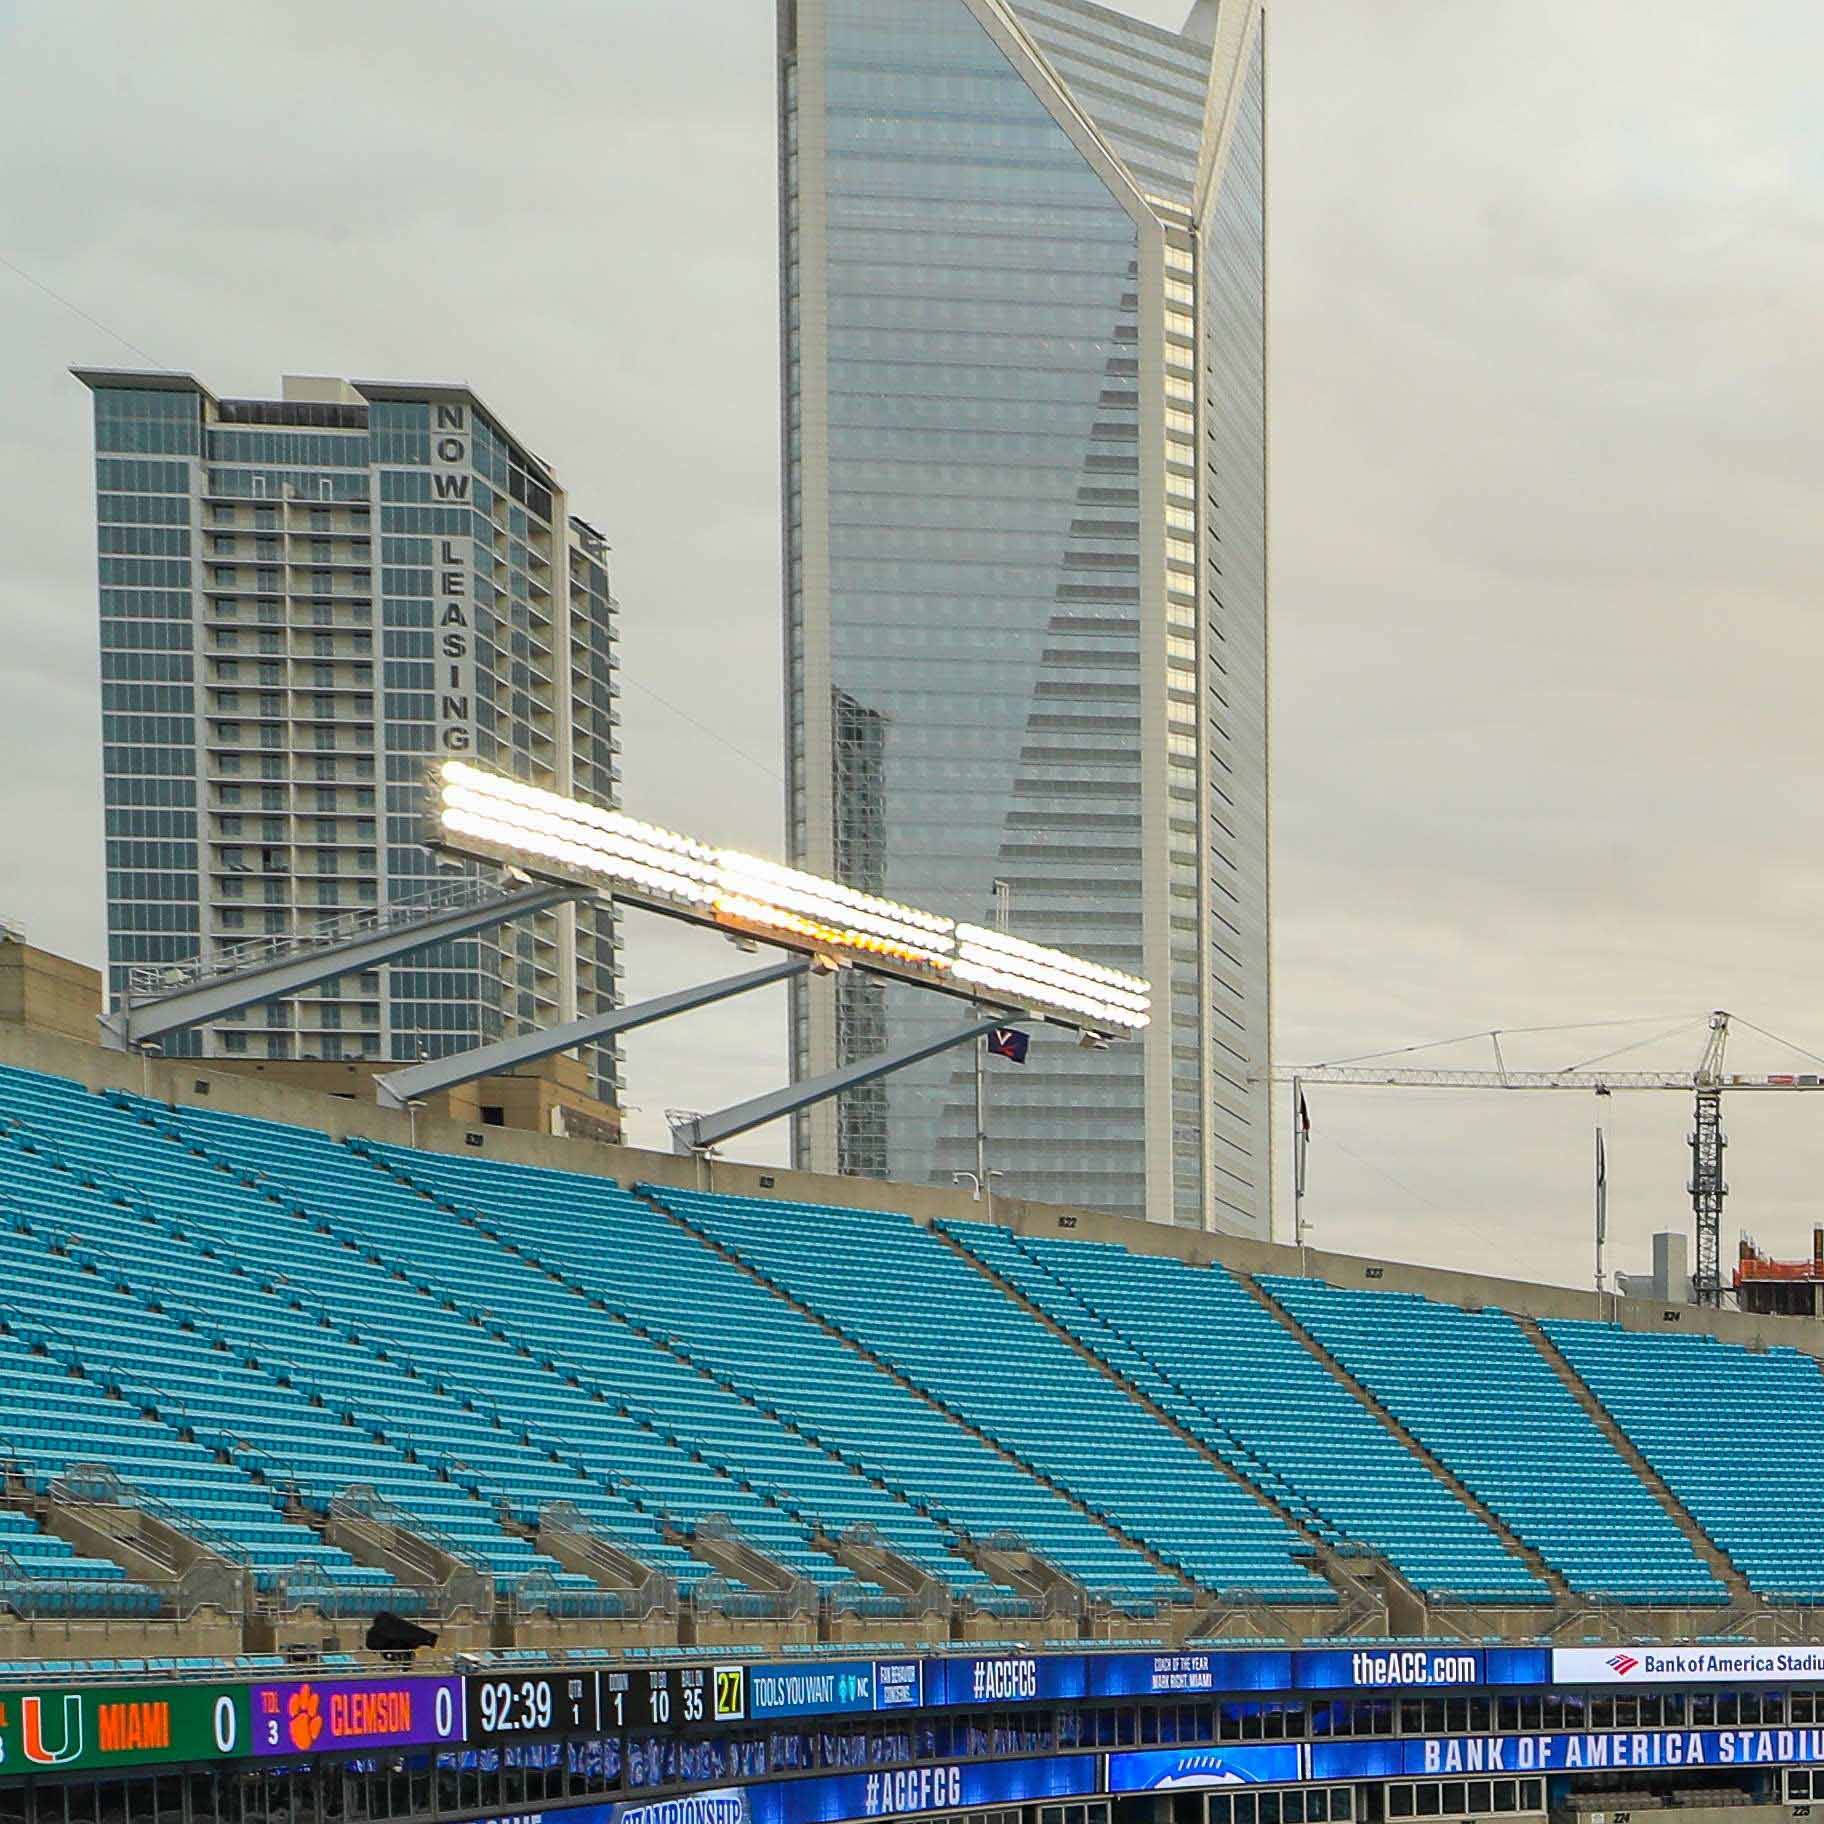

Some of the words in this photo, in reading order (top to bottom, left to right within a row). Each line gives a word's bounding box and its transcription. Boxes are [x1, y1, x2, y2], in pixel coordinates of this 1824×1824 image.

[433, 406, 468, 499] NOW
[440, 541, 470, 752] LEASING
[973, 1659, 1037, 1700] #ACCFCG
[1352, 1652, 1475, 1686] theACC.com
[1645, 1655, 1686, 1674] Bank
[1688, 1655, 1705, 1674] of
[1707, 1655, 1774, 1673] America
[481, 1680, 553, 1731] 92:39
[684, 1691, 704, 1721] 35
[717, 1672, 741, 1714] 27
[754, 1677, 784, 1707] TOOLS
[785, 1677, 804, 1705] YOU
[805, 1675, 834, 1703] WANT
[857, 1675, 869, 1698] NC
[99, 1701, 171, 1752] MIAMI
[214, 1696, 237, 1753] 0
[330, 1690, 412, 1737] CLEMSON
[435, 1687, 452, 1737] 0
[572, 1704, 580, 1726] 1
[613, 1693, 624, 1726] 1
[650, 1692, 670, 1724] 10
[267, 1720, 279, 1745] 3
[1425, 1738, 1504, 1772] BANK
[1518, 1737, 1552, 1770] OF
[1565, 1731, 1704, 1767] AMERICA
[866, 1766, 961, 1816] #ACCFCG
